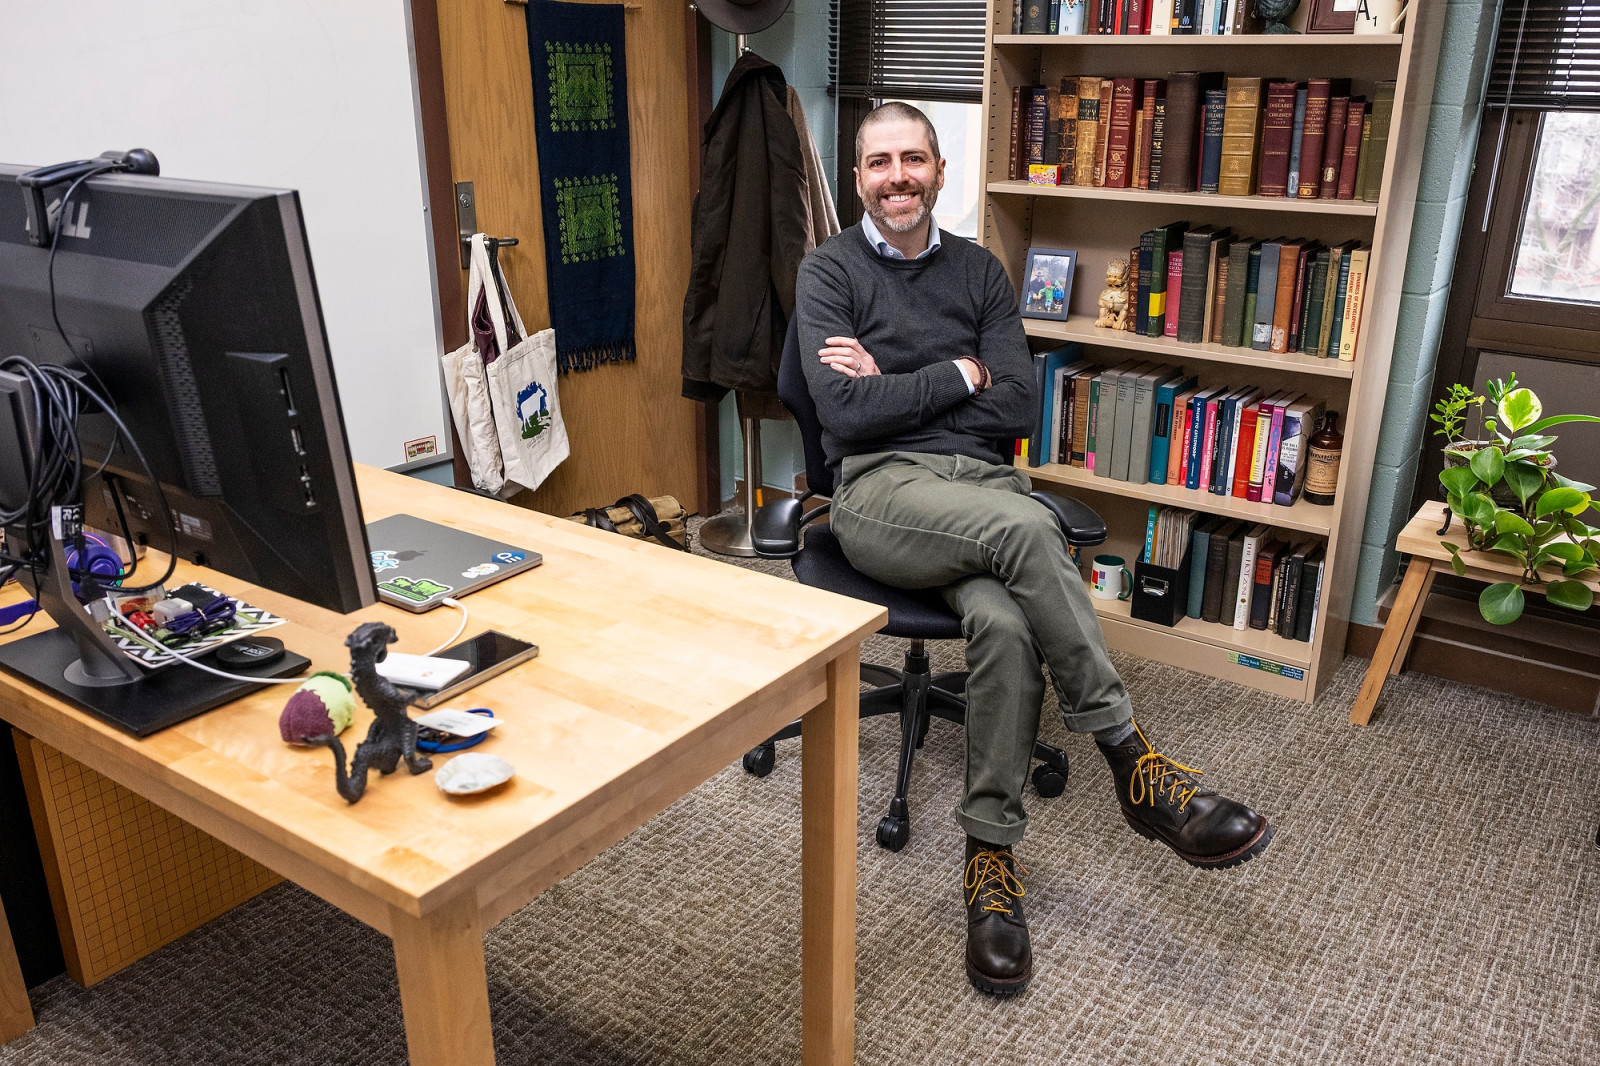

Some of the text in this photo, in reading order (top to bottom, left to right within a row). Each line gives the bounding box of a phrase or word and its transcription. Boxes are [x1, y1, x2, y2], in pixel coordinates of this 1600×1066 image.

[25, 198, 91, 239] ELL
[1347, 272, 1355, 294] EUTHENIC
[1349, 302, 1358, 335] DEVELOPMENT:
[1268, 427, 1280, 472] AMERICA
[1243, 559, 1252, 577] HOT
[1240, 577, 1249, 597] ZONE
